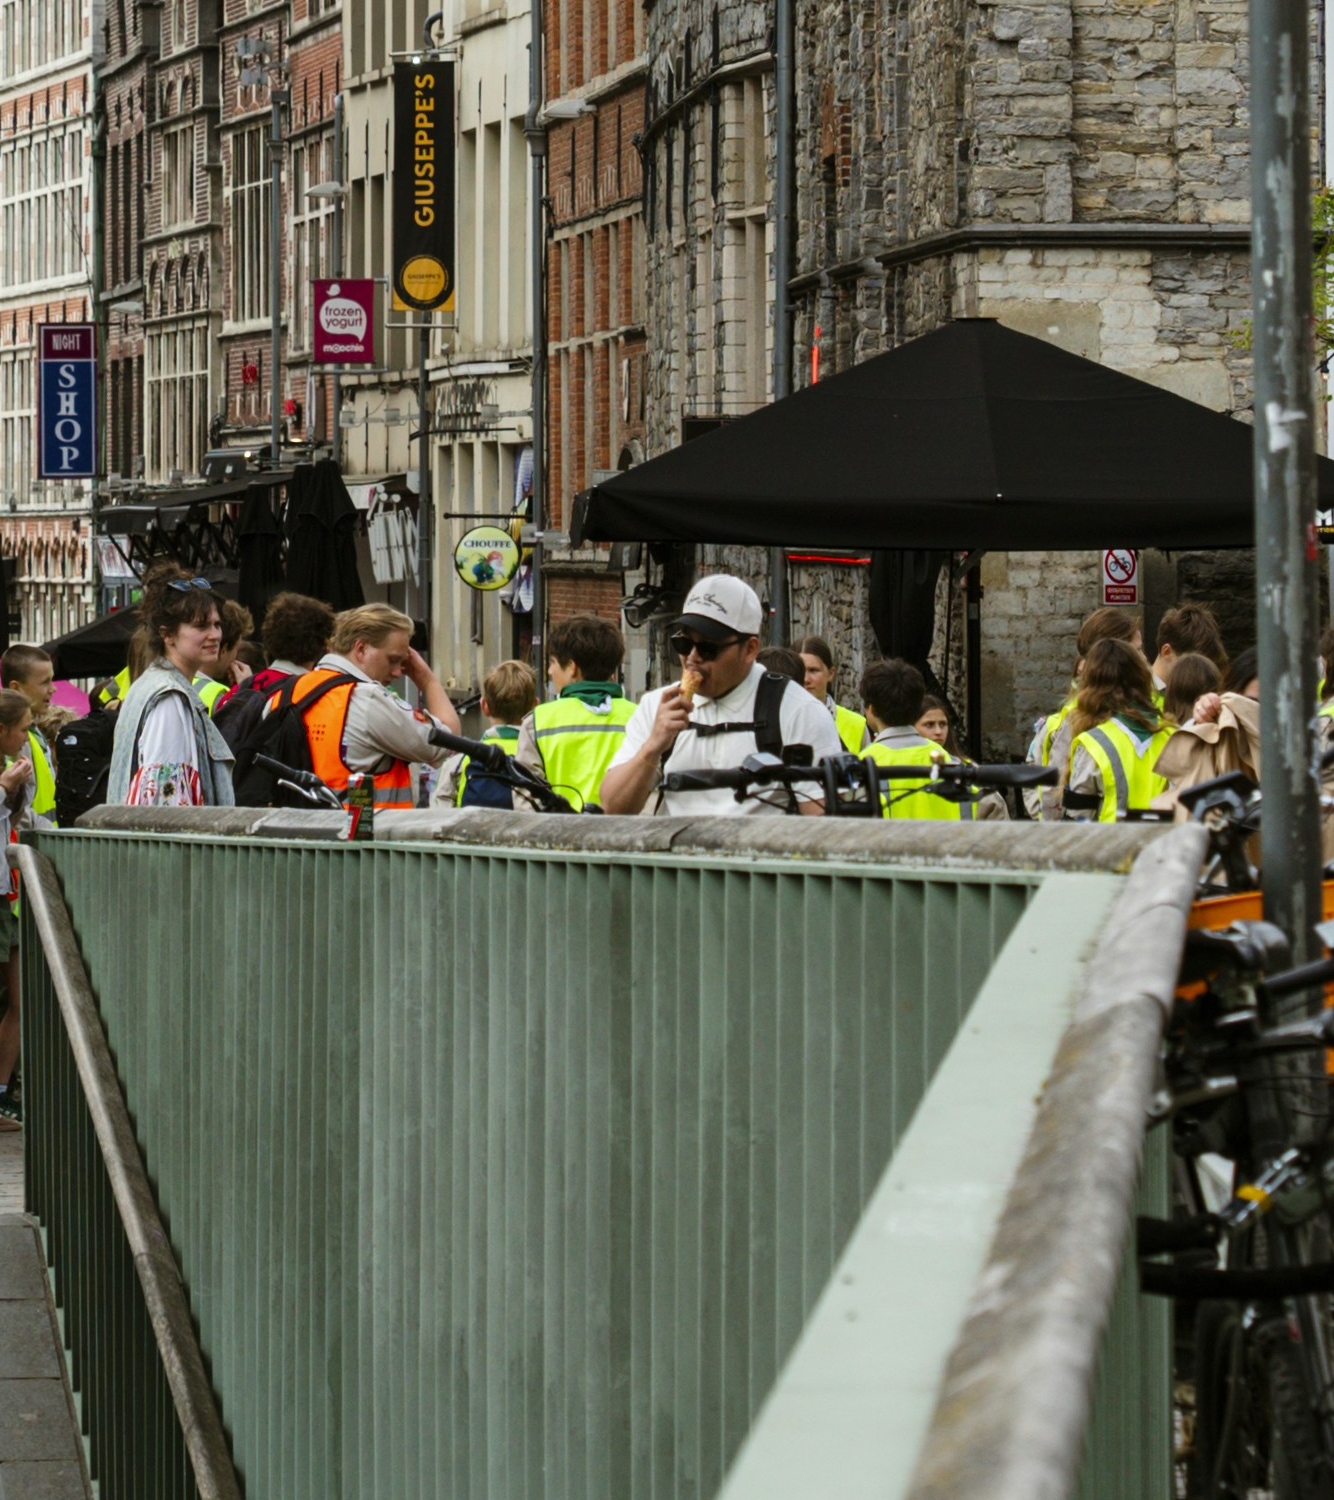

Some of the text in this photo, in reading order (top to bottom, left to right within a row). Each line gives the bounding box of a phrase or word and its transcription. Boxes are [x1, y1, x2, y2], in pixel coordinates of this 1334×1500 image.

[414, 73, 436, 228] GIUSEPPE'S
[325, 306, 362, 316] frozen
[325, 316, 363, 330] yogurt
[51, 333, 82, 350] NIGHT
[54, 363, 82, 470] SHOP
[463, 539, 512, 548] CHOUFFE
